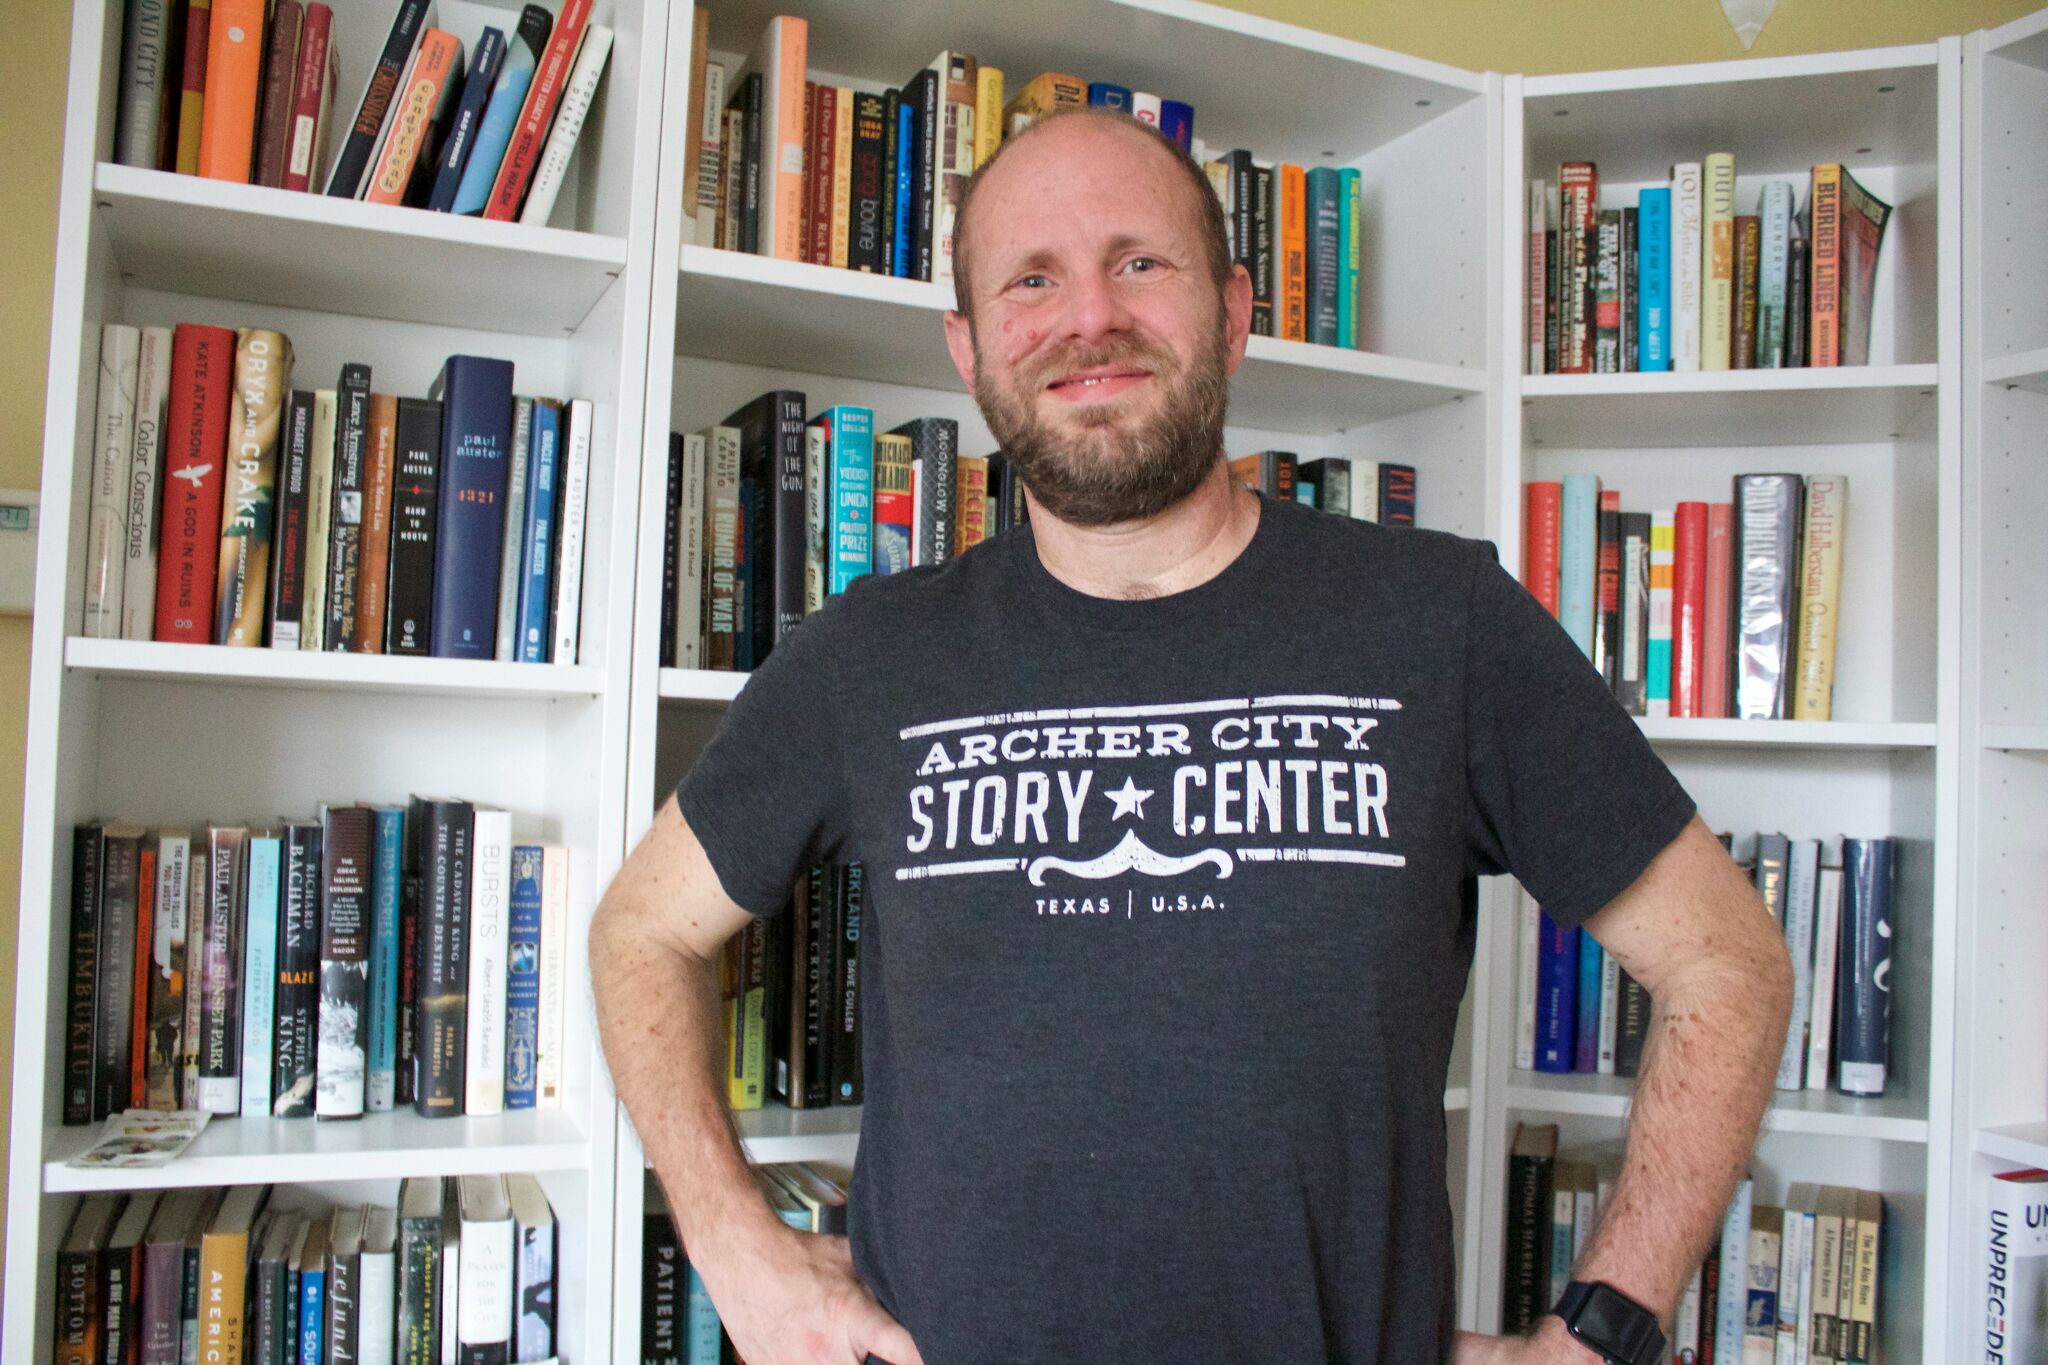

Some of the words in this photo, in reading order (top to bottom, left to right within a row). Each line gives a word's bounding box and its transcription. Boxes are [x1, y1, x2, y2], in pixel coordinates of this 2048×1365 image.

[135, 43, 160, 92] CITY
[559, 86, 581, 135] DIARY
[569, 69, 598, 138] CODEINE
[516, 132, 535, 172] STELLA
[745, 163, 758, 210] Fractals
[1254, 173, 1270, 222] Running
[1680, 170, 1697, 202] 101
[1714, 163, 1731, 218] DUTY
[858, 198, 881, 251] bovine
[1574, 185, 1589, 239] Killers
[1816, 181, 1837, 260] BLURRED
[816, 221, 828, 249] Rick
[835, 223, 847, 260] MAN
[1258, 223, 1269, 249] with
[1772, 212, 1785, 273] HUNGRY
[1257, 251, 1269, 296] Scissors
[1573, 265, 1587, 321] Flower
[1608, 255, 1619, 291] LOST
[1814, 263, 1835, 314] LINES
[1680, 280, 1694, 313] Bible
[193, 341, 209, 380] KATE
[1572, 322, 1587, 368] Moon
[1607, 339, 1618, 372] David
[245, 339, 270, 405] ORYX
[188, 383, 206, 459] ATKINSON
[244, 410, 257, 434] AND
[292, 406, 307, 453] MARGARET
[350, 391, 366, 426] Lance
[517, 402, 532, 436] PAUL
[781, 421, 805, 434] NIGHT
[784, 402, 801, 419] THE
[136, 420, 156, 467] Color
[342, 427, 363, 488] Armstrong
[409, 450, 429, 461] PAUL
[464, 435, 496, 447] paul
[574, 435, 586, 466] PAUL
[717, 435, 727, 488] CAPUTO
[786, 436, 799, 452] OF
[101, 446, 121, 497] Canon
[289, 455, 304, 494] ATWOOD
[403, 464, 434, 476] AUSTER
[511, 440, 528, 495] AUSTER
[727, 441, 737, 485] PHILIP
[781, 473, 803, 491] GUN
[784, 457, 801, 474] THE
[935, 428, 949, 513] MOONGLOW
[186, 493, 199, 508] A
[234, 443, 262, 529] CRAKE
[571, 478, 583, 525] AUSTER
[840, 491, 868, 507] UNION
[1809, 481, 1835, 519] David
[129, 472, 152, 559] Conscious
[182, 509, 198, 539] GOD
[405, 506, 426, 517] HAND
[410, 519, 421, 529] TO
[535, 519, 549, 541] PAUL
[180, 543, 196, 558] IN
[236, 535, 247, 578] MARGARET
[400, 531, 428, 543] MOUTH
[713, 512, 736, 568] RUMOR
[840, 535, 868, 551] PRIZE
[1806, 522, 1833, 597] Halberstam
[178, 561, 194, 609] RUINS
[232, 579, 243, 619] ATWOOD
[713, 571, 735, 594] OF
[711, 597, 734, 634] WAR
[916, 723, 1192, 777] ARCHER
[1212, 714, 1379, 751] CITY
[906, 769, 1094, 853] STORY
[1172, 759, 1390, 839] CENTER
[174, 844, 184, 859] THE
[438, 824, 449, 852] THE
[454, 829, 465, 857] THE
[215, 848, 231, 889] PAUL
[434, 855, 447, 921] COUNTRY
[287, 844, 304, 948] BACHMAN
[303, 863, 316, 931] RICHARD
[380, 875, 395, 938] STORIES
[451, 860, 464, 924] CADAVER
[480, 845, 501, 939] BURSTS
[1036, 898, 1111, 916] TEXAS
[1151, 894, 1226, 914] U.S.A.
[214, 890, 229, 954] AUSTER
[432, 924, 444, 985] DENTIST
[450, 927, 461, 963] KING
[211, 964, 226, 1026] SUNSET
[280, 971, 315, 985] BLAZE
[807, 942, 820, 1046] CRONKITE
[845, 959, 856, 988] DAVE
[72, 931, 96, 1076] TIMBUKTU
[843, 990, 855, 1033] CULLEN
[209, 1028, 224, 1070] PARK
[279, 1014, 294, 1069] KING
[294, 1007, 308, 1075] STEPHEN
[1522, 1165, 1537, 1225] THOMAS
[1520, 1229, 1535, 1286] HARRIS
[1862, 1250, 1874, 1265] Sun
[1864, 1234, 1875, 1248] The
[1859, 1283, 1871, 1306] Rises
[1861, 1265, 1872, 1283] Also
[207, 1270, 223, 1364] AMERIC
[306, 1310, 315, 1328] THE
[329, 1262, 354, 1361] refund
[655, 1247, 675, 1350] PATIENT
